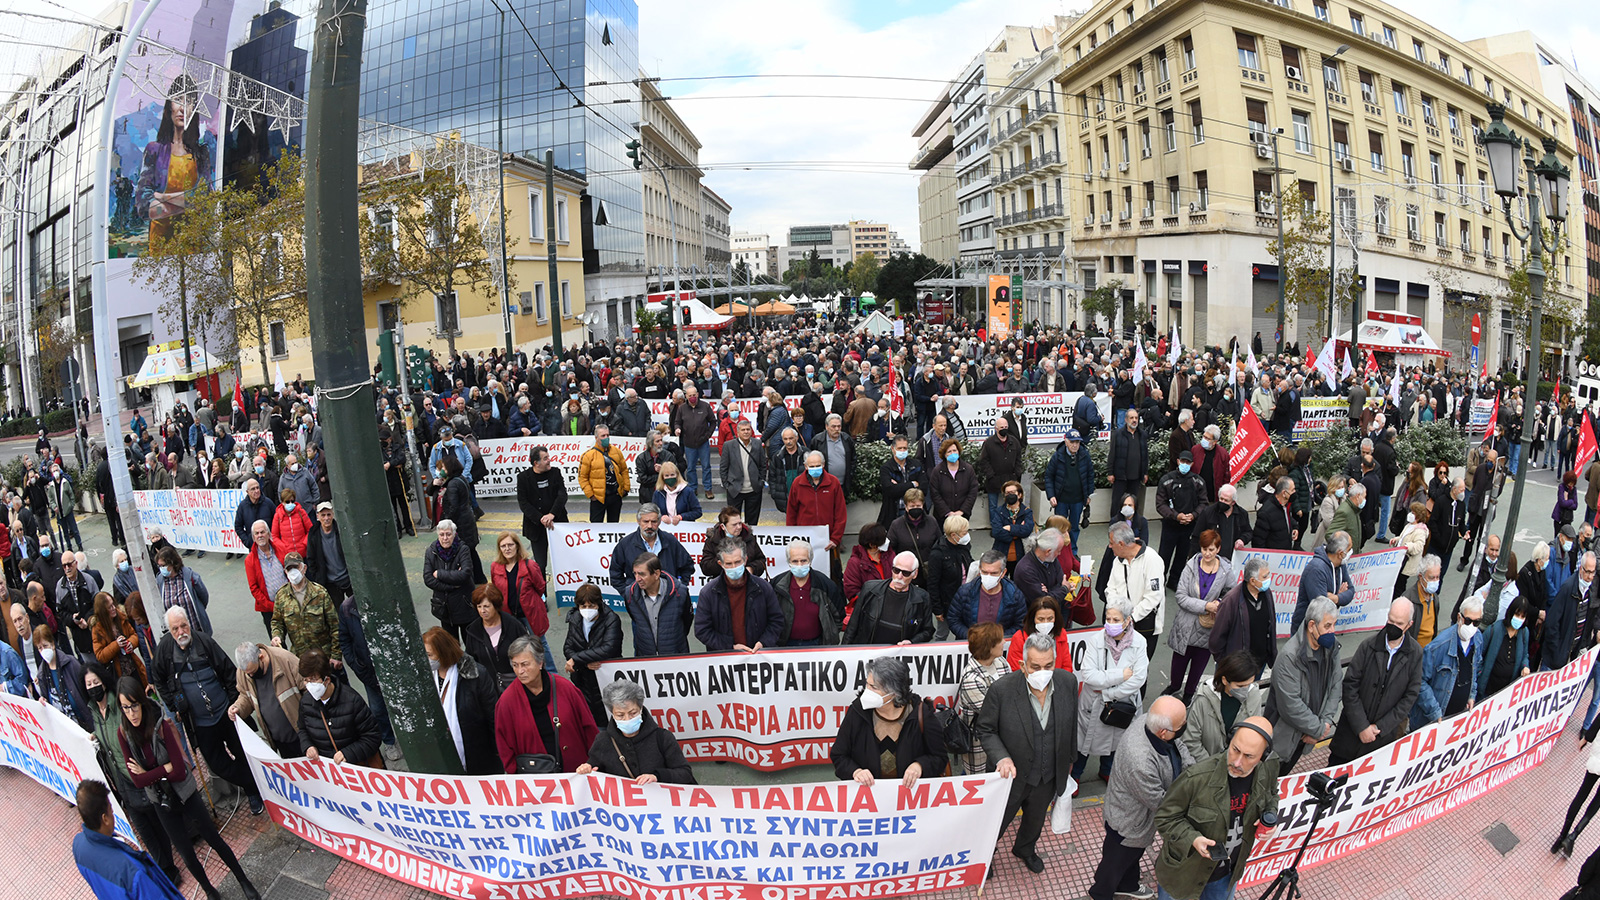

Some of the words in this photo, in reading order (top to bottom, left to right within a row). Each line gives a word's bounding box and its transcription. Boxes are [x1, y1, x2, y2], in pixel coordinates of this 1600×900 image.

[998, 396, 1061, 405] ΔΙΕΙΚΟΥΜΕ
[1303, 410, 1327, 418] ΠΑΡΤΕ
[967, 418, 996, 427] ΔΗΜΟ
[1028, 417, 1059, 425] ΣΤΗΜΑ
[565, 529, 594, 547] ΟΧΙ
[671, 533, 707, 543] ΜΕΙΩΣ
[556, 570, 583, 585] ΟΧΙ
[654, 671, 702, 698] ΣΤΟΝ
[708, 659, 848, 696] ΑΝΤΕΡΓΑΤΙΚΟ
[688, 711, 714, 731] ΤΑ
[717, 702, 781, 735] ΧΕΡΙΑ
[787, 705, 826, 731] ΑΠΟ
[1389, 728, 1438, 767] ΓΙΑ
[1445, 699, 1495, 746] ΖΩΗ
[1508, 651, 1592, 710] ΕΠΙΒΙΩΣΗ
[683, 741, 775, 767] ΔΕΣΜΟΣ
[1361, 776, 1396, 807] ΣΕ
[1396, 729, 1488, 792] ΜΙΣΘΟΥΣ
[1486, 716, 1512, 746] ΚΑΙ
[1346, 758, 1478, 833] ΠΡΟΣΤΑΣΙΑΣ
[1480, 738, 1511, 771] ΤΗΣ
[1516, 712, 1564, 754] ΥΓΕΙΑΣ
[478, 778, 575, 806] ΜΑΖΙ
[586, 775, 648, 807] ΜΕ
[660, 784, 717, 808] ΤΑ
[732, 784, 878, 813] ΠΑΙΔΙΑ
[896, 779, 986, 811] ΜΑΣ
[377, 801, 476, 829] ΑΥΞΗΣΕΙΣ
[480, 812, 545, 830] ΣΤΟΥΣ
[551, 807, 665, 835] ΜΙΣΘΟΥΣ
[673, 816, 711, 834] ΚΑΙ
[720, 817, 756, 834] ΤΙΣ
[766, 815, 917, 837] ΣΥΝΤΑΞΕΙΣ
[1237, 843, 1329, 886] ΥΝΤΑΞΙΟΧΩΝ
[1327, 827, 1372, 857] ΚΥΡΙΑΣ
[1445, 773, 1489, 812] ΑΣΦΑΛΙΣΗΣ
[278, 807, 476, 900] ΣΥΝΕΡΓΑΖΟΜΕΝΕΣ
[484, 874, 745, 900] ΣΥΝΤΑΞΙΟΥΧΙΚΕΣ
[761, 869, 966, 900] ΟΡΓΑΝΩΣΕΙΣ
[388, 822, 466, 850] ΜΕΙΩΣΗ
[469, 836, 509, 851] ΤΗΣ
[512, 833, 586, 857] ΤΙΜΗΣ
[592, 832, 634, 856] ΤΩΝ
[641, 839, 759, 860] ΒΑΣΙΚΩΝ
[769, 842, 878, 858] ΑΓΑΘΩΝ
[468, 852, 608, 879] ΠΡΟΣΤΑΣΙΑΣ
[612, 857, 650, 881] ΤΗΣ
[656, 864, 748, 882] ΥΓΕΙΑΣ
[757, 866, 793, 882] ΚΑΙ
[803, 865, 845, 880] ΤΗΣ
[855, 861, 909, 880] ΖΩΗ
[918, 850, 971, 872] ΜΑΣ
